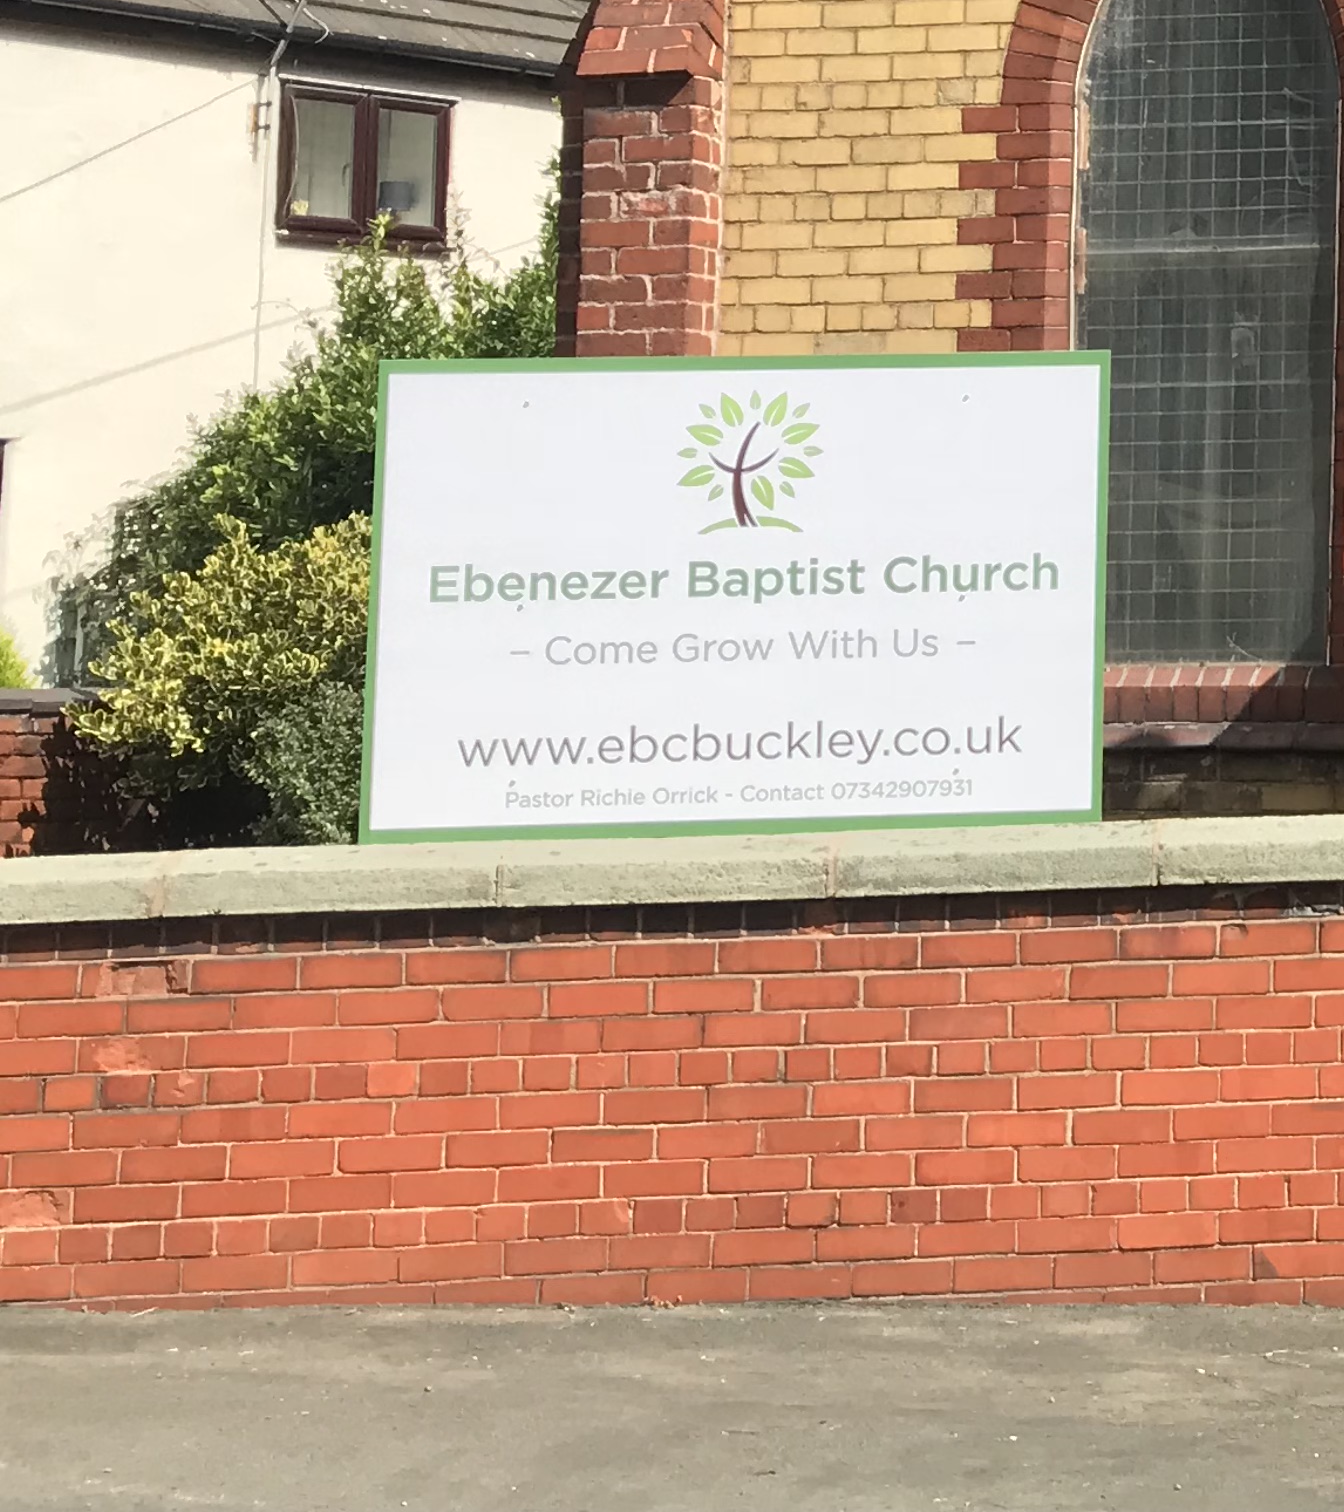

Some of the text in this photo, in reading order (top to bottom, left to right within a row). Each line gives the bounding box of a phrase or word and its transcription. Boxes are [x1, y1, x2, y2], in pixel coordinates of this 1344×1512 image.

[429, 552, 1059, 605] Ebenezer Baptist Church
[545, 635, 659, 666] Come
[672, 633, 775, 663] Grow
[788, 628, 878, 660] With
[893, 628, 939, 658] Us
[457, 716, 1023, 766] www.ebcbuckley.co.uk
[504, 791, 573, 810] Pastor
[580, 788, 646, 807] Richie
[652, 785, 718, 805] Orrick
[740, 784, 825, 802] Contact
[831, 779, 973, 801] 07342907931
